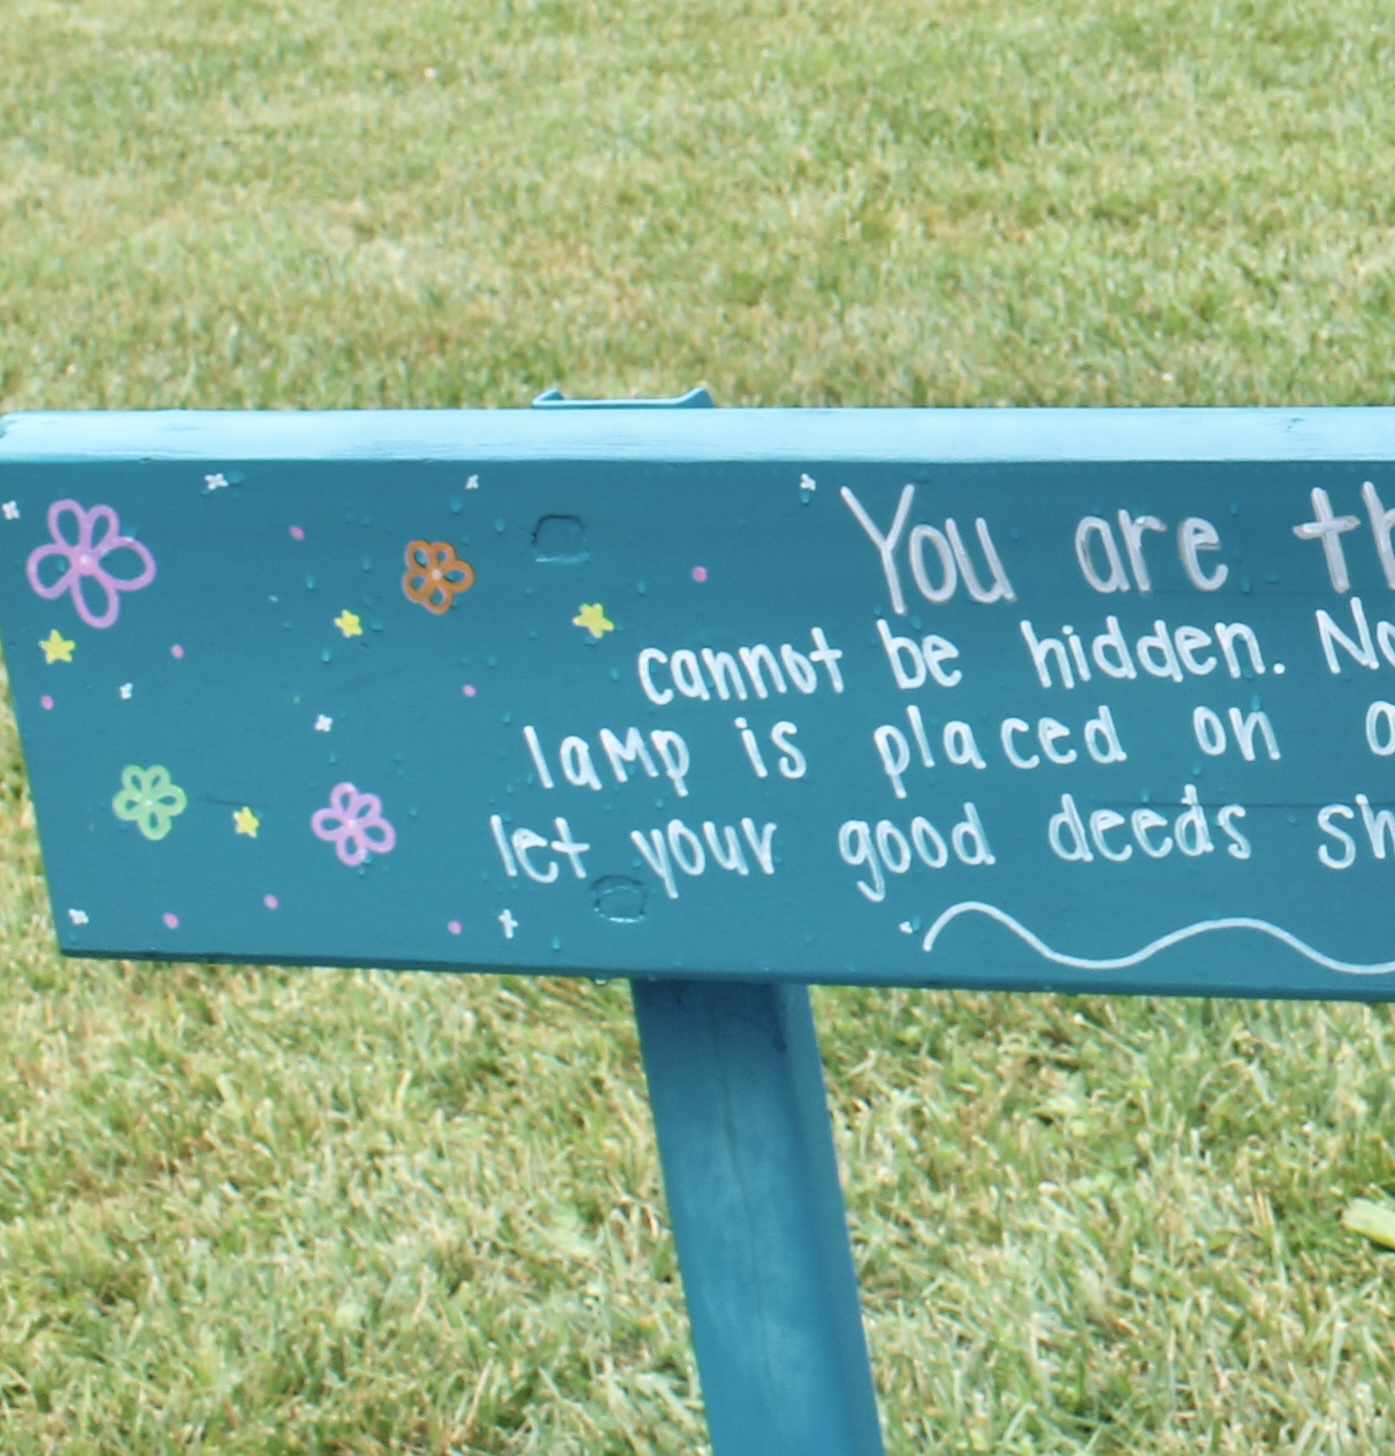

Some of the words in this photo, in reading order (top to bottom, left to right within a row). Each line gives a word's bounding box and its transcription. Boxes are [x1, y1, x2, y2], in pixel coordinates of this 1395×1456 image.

[840, 484, 1016, 614] You
[1075, 509, 1228, 594] are
[637, 627, 844, 706] cannot
[876, 619, 962, 690] be
[1020, 615, 1286, 689] hidden.
[734, 717, 807, 779] is
[873, 704, 1128, 799] placed
[1192, 706, 1281, 762] on
[489, 814, 590, 884] let
[630, 817, 778, 899] your
[838, 802, 998, 902] good
[1048, 784, 1251, 862] deeds
